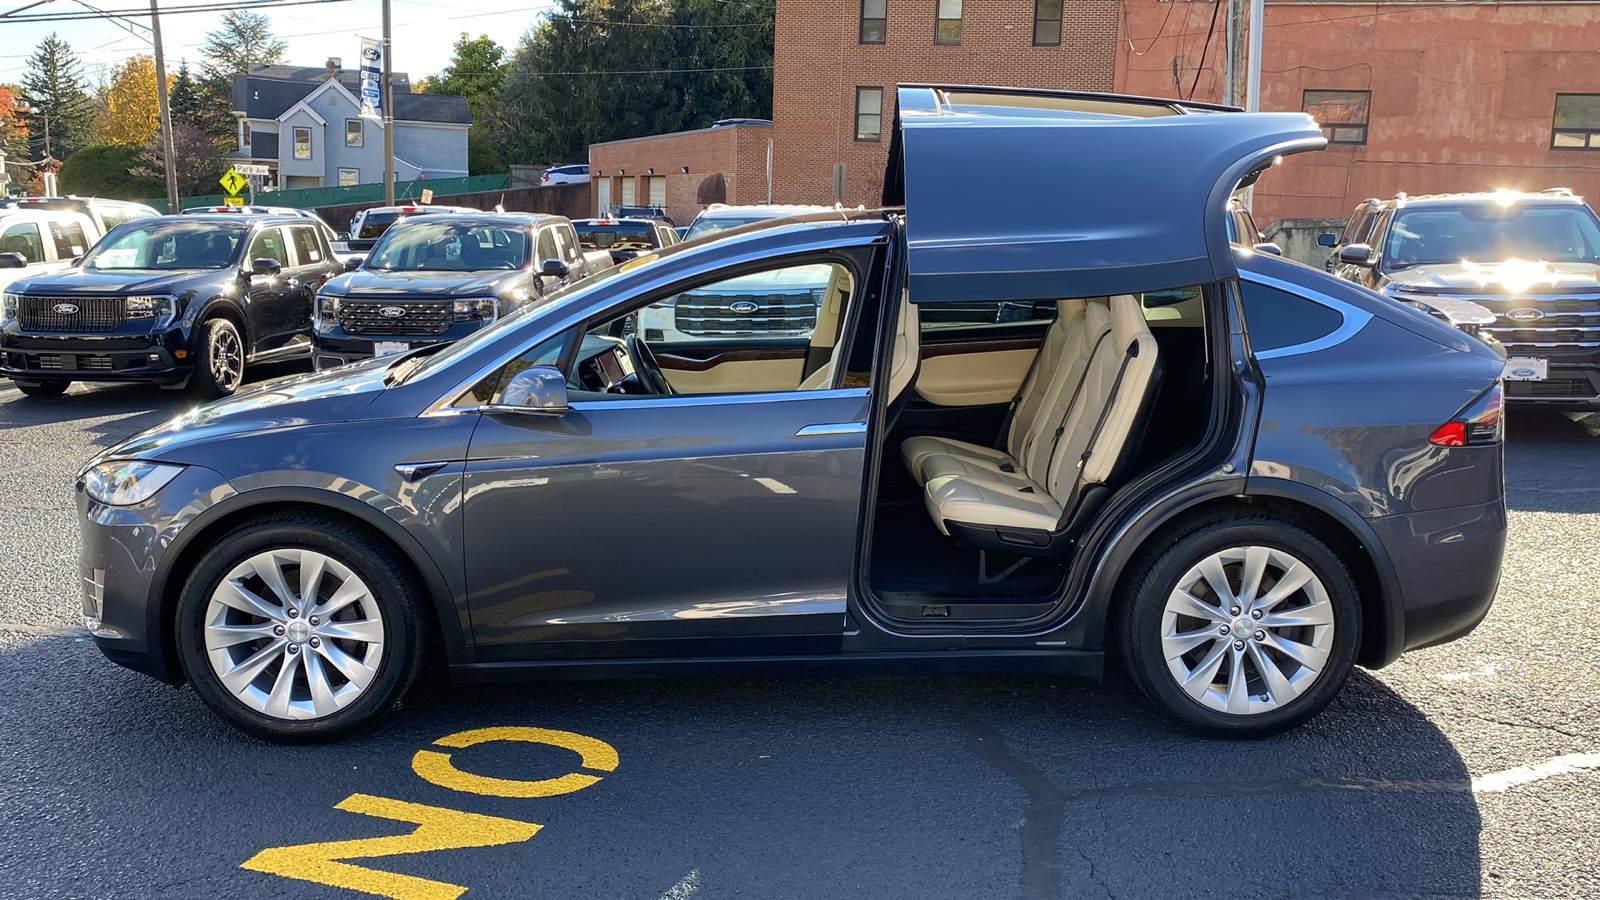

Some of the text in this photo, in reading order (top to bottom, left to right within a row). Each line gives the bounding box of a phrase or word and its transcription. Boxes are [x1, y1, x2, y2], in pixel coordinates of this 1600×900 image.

[237, 165, 254, 173] Park
[1513, 309, 1537, 319] Ford
[239, 726, 619, 900] NO
